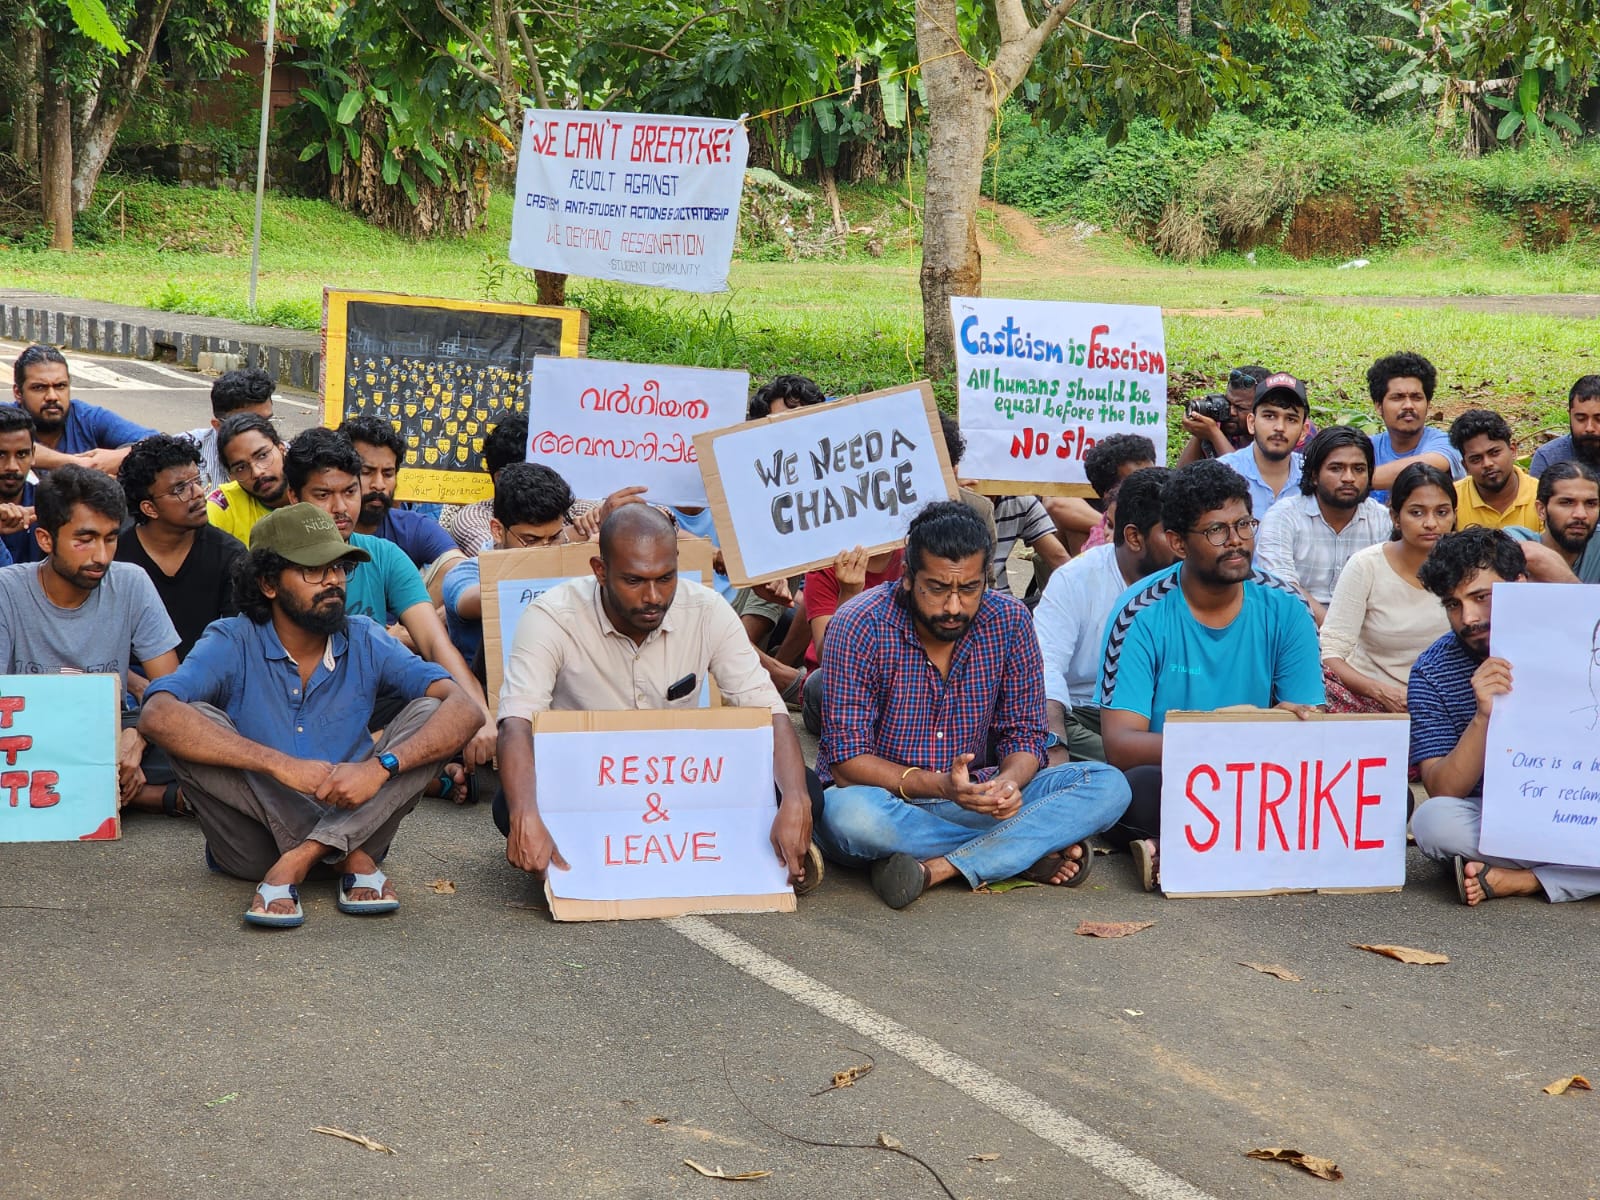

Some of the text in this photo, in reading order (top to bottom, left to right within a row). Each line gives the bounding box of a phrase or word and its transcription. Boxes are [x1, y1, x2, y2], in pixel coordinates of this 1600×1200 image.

[564, 118, 623, 161] CAN'T
[630, 124, 734, 165] BREATHE!
[569, 169, 679, 197] REVOLT AGAINST
[565, 200, 628, 218] ANTI-STUDENT
[547, 224, 705, 256] WE DEMAND RESIGNATION
[652, 261, 700, 276] COMMUNITY
[960, 315, 1165, 374] Casteism is Fascism
[966, 368, 1151, 404] All humans should be
[994, 396, 1160, 426] equal before the law
[754, 428, 918, 489] WE NEED A
[771, 459, 918, 535] CHANGE
[597, 755, 725, 786] RESIGN
[1551, 757, 1561, 769] is
[1572, 760, 1582, 771] a
[1184, 757, 1388, 853] STRIKE
[1520, 780, 1549, 798] For
[642, 792, 670, 824] &
[1552, 809, 1598, 825] human
[604, 831, 722, 866] LEAVE
